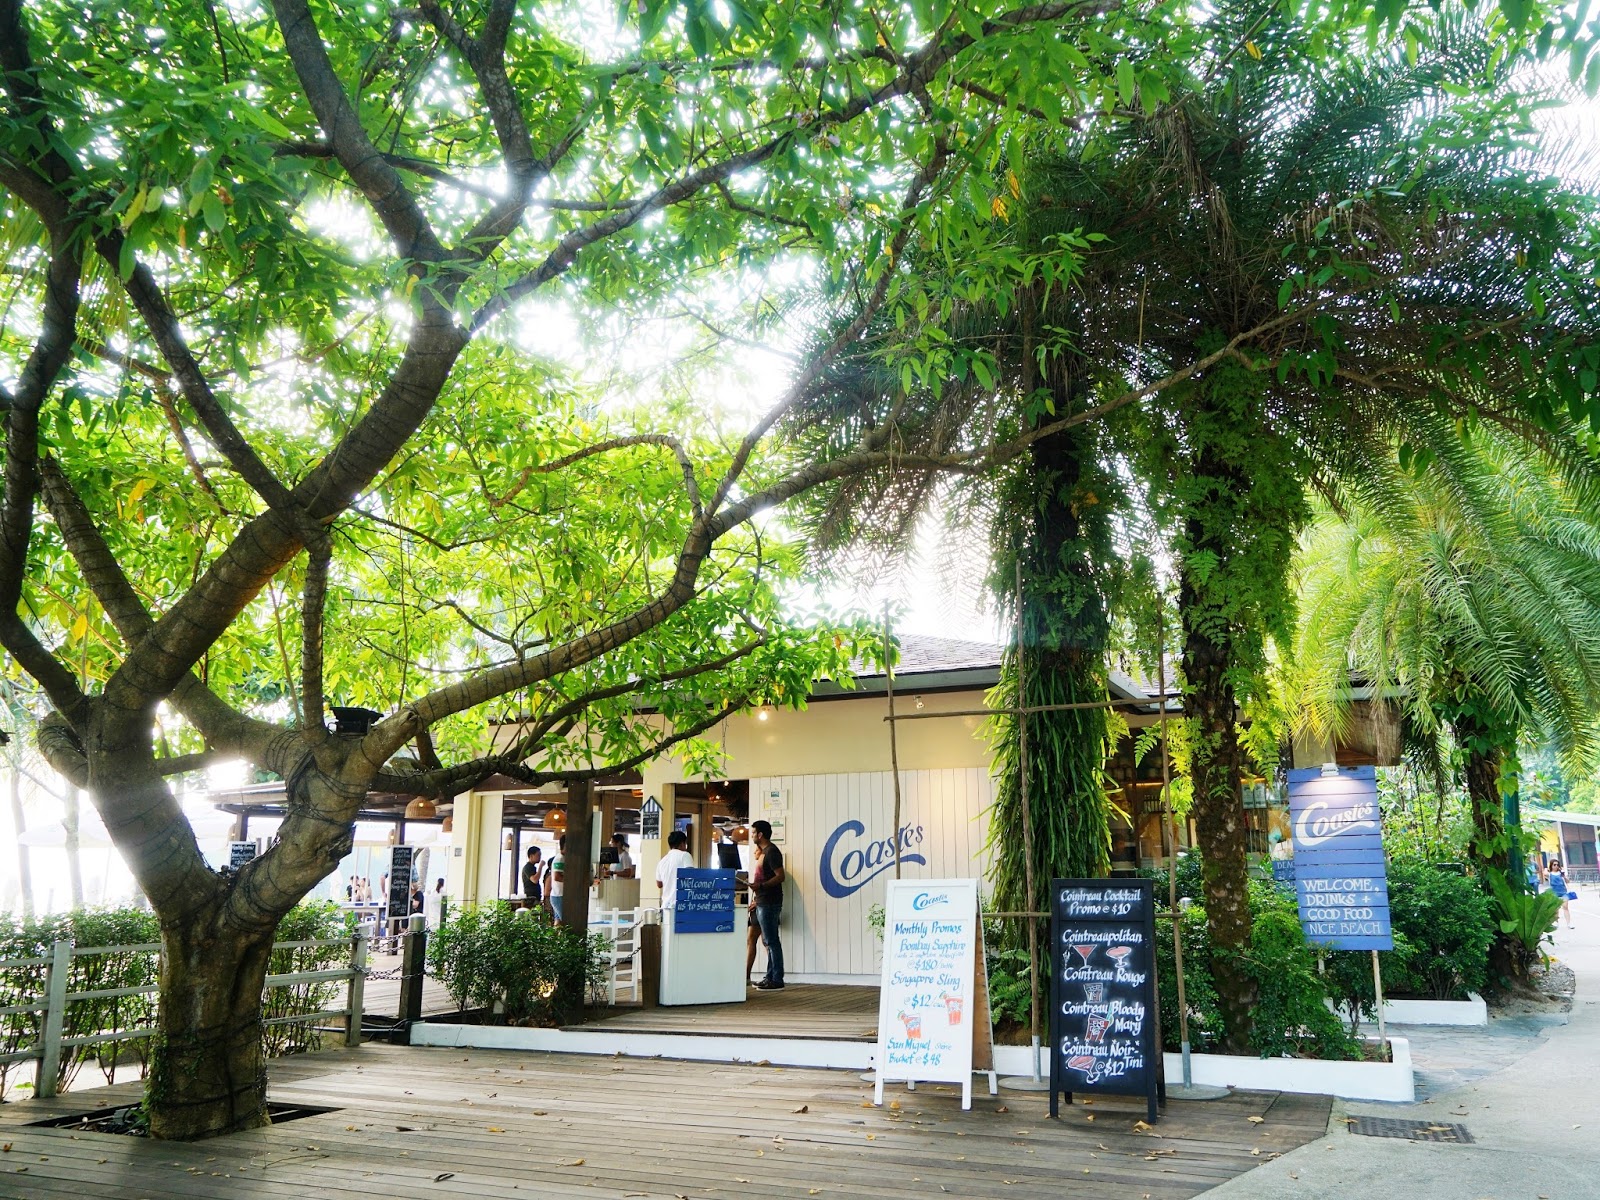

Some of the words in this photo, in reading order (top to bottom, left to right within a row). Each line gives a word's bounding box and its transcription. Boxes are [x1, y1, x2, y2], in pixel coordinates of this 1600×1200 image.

[680, 879, 716, 888] Welcome!
[687, 890, 710, 900] Please
[711, 890, 731, 900] allow
[1060, 889, 1102, 902] Cointreau
[1103, 888, 1142, 902] Cocktail
[1305, 892, 1356, 907] DRINKS
[677, 902, 686, 910] us
[687, 901, 696, 910] to
[696, 901, 712, 911] seat
[1070, 901, 1102, 916] Promo
[1111, 903, 1132, 916] $10
[1307, 908, 1341, 921] GOOD
[1343, 907, 1373, 920] FOOD
[894, 921, 928, 939] Monthly
[931, 920, 962, 934] Promos
[1309, 922, 1336, 935] NICE
[1340, 920, 1381, 935] BEACH
[1062, 928, 1143, 946] Cointreaupolitan
[900, 938, 931, 955] Bombay
[932, 938, 966, 953] Sapphire
[891, 970, 934, 987] Singapore
[937, 972, 961, 991] Sling
[1063, 966, 1113, 981] Cointreau
[1115, 967, 1146, 988] Rouge
[1062, 1000, 1108, 1015] Cointreau
[1110, 1000, 1145, 1022] Bloody
[1114, 1017, 1142, 1036] Mary
[887, 1037, 904, 1050] San
[904, 1037, 931, 1054] Miguel
[1061, 1041, 1108, 1057] Cointreau
[1122, 1055, 1144, 1069] Tini
